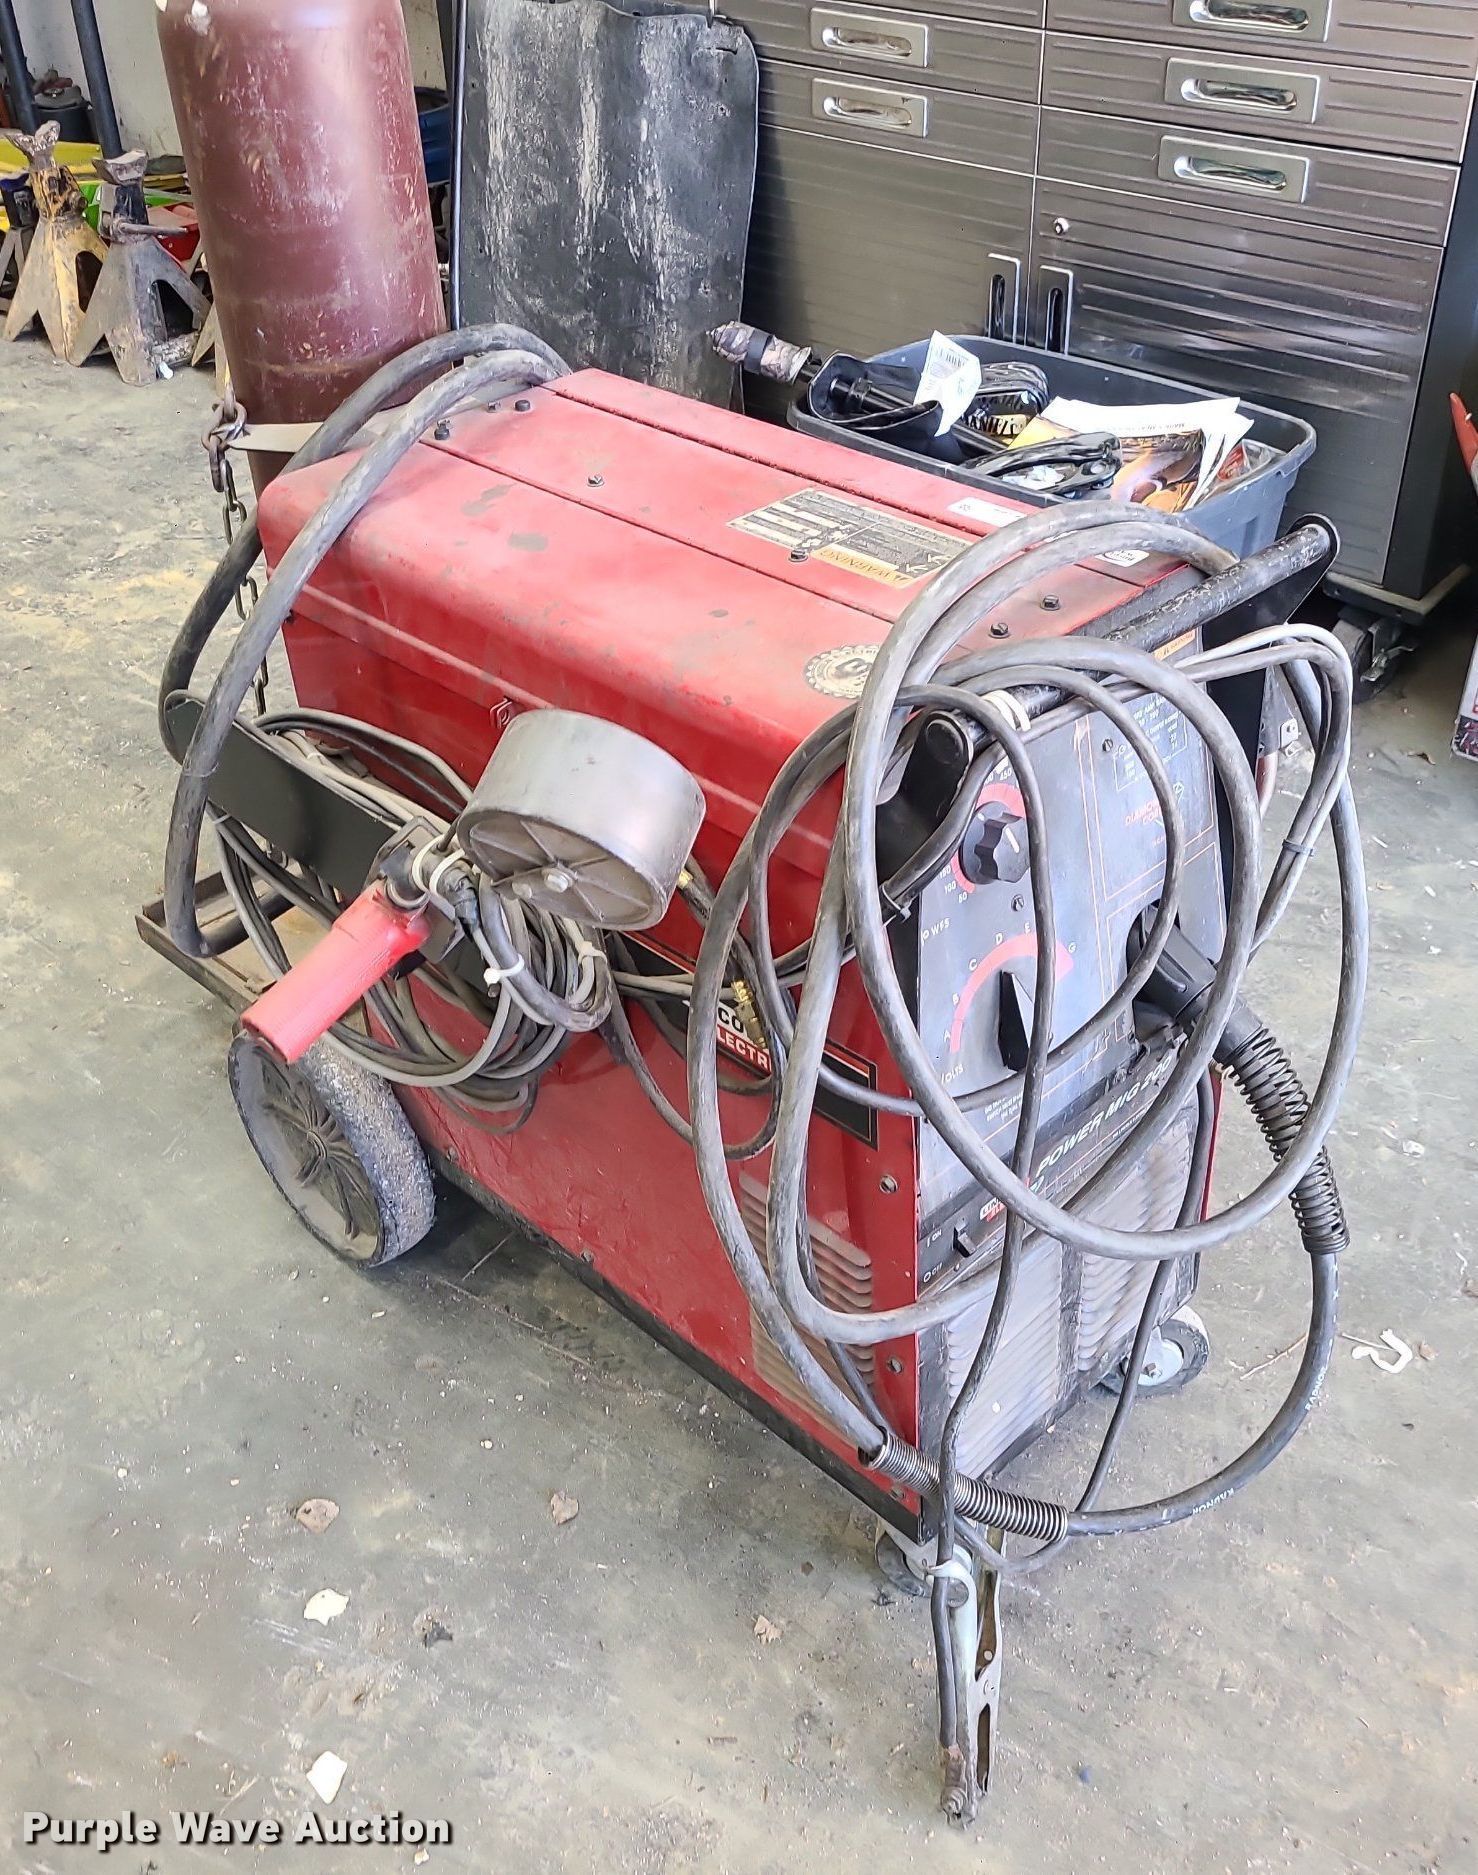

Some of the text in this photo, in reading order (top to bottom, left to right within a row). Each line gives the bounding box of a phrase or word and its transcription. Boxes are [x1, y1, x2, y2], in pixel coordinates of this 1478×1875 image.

[1036, 1111, 1105, 1178] POWER
[1104, 1082, 1141, 1121] MIG
[1141, 1055, 1172, 1091] 200
[1304, 1366, 1327, 1411] RADNOR
